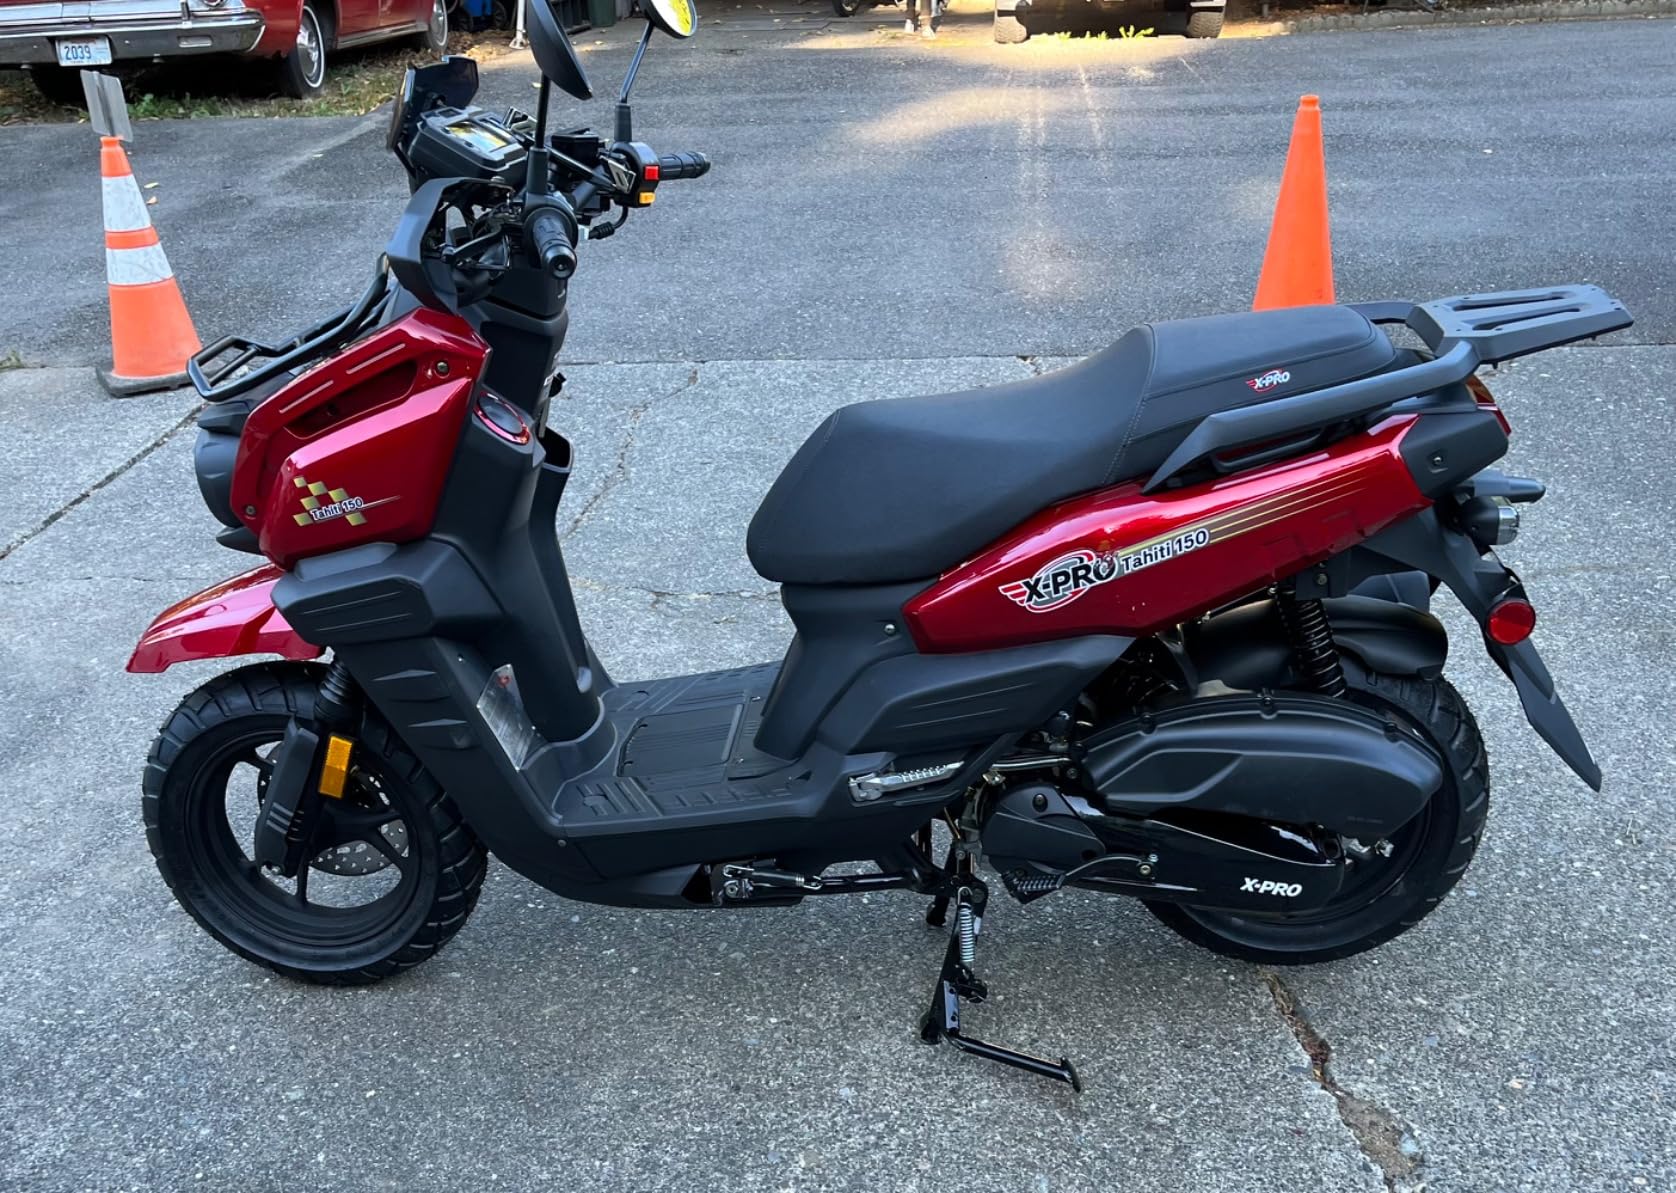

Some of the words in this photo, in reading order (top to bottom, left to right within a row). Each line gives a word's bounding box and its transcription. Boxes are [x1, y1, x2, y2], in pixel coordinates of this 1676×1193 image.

[64, 45, 91, 60] 2039
[1254, 371, 1290, 389] X-PRO
[311, 503, 341, 520] Tahiti
[342, 497, 363, 511] 150
[1022, 557, 1116, 604] X-PRO
[1122, 542, 1171, 572] Tahiti
[1174, 530, 1208, 553] 150
[1240, 877, 1302, 897] X-PRO
